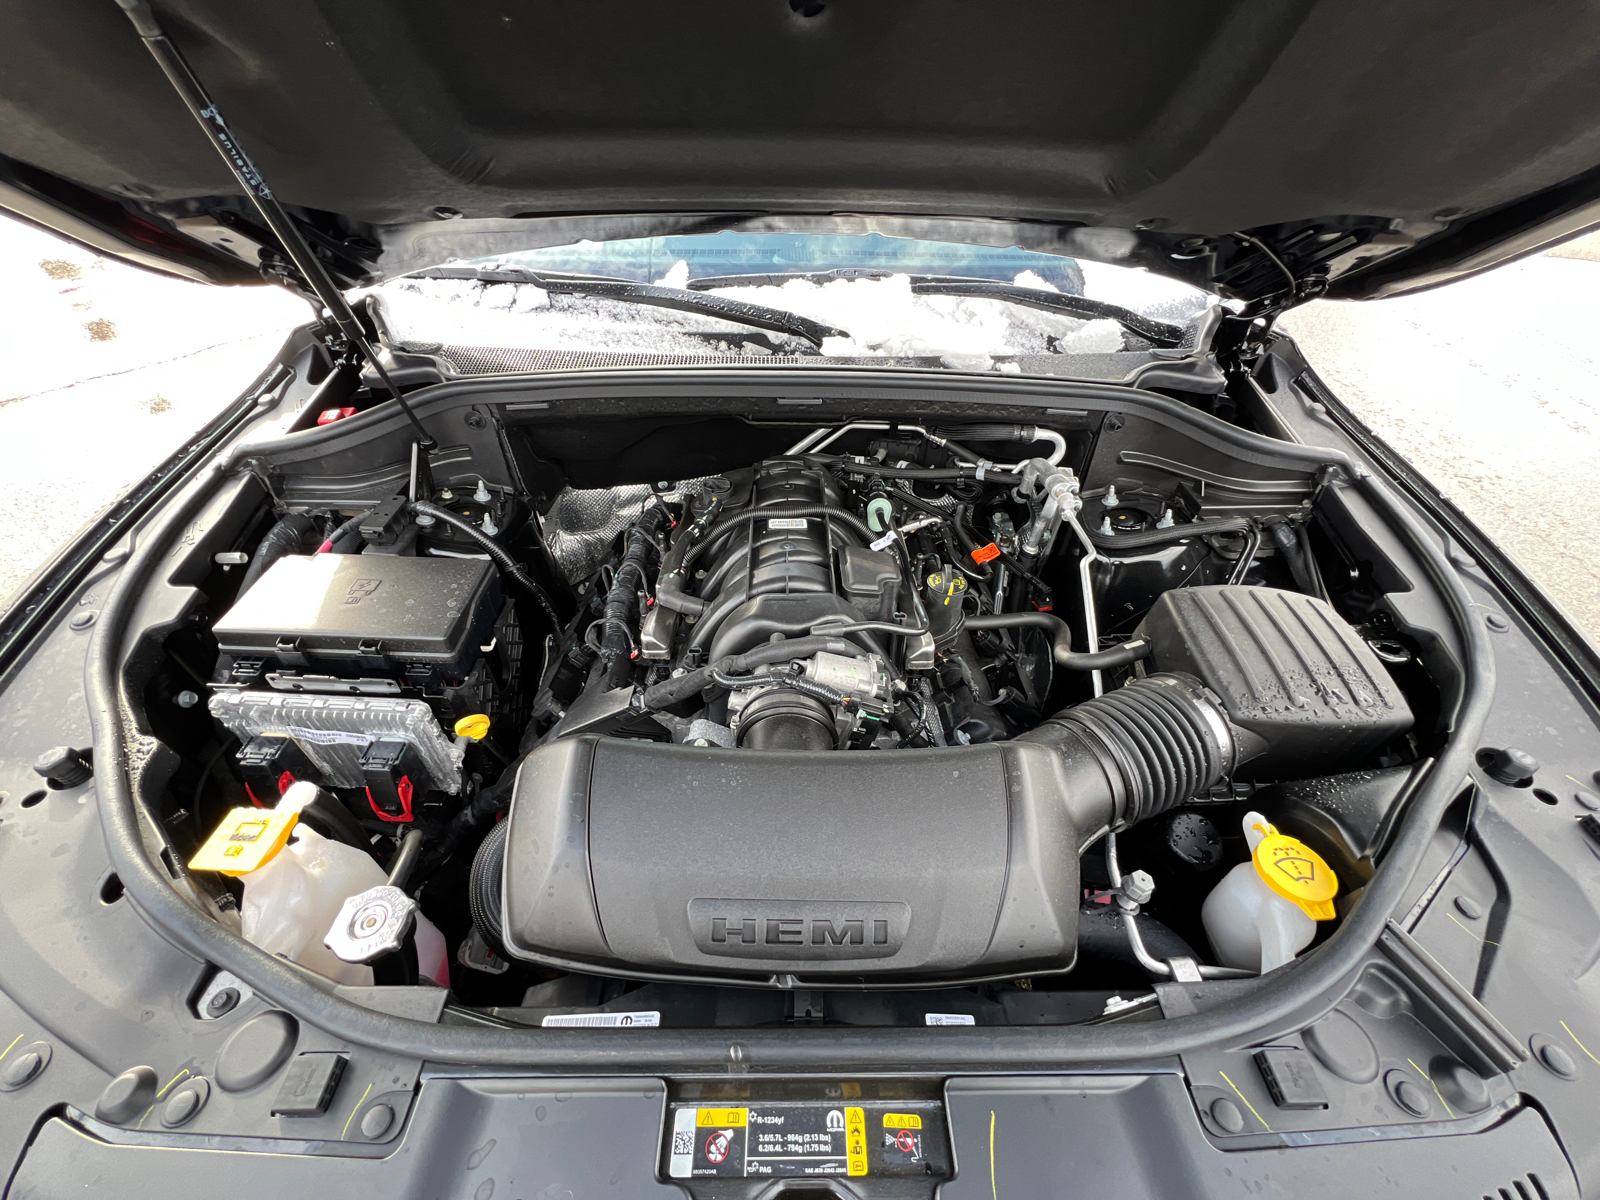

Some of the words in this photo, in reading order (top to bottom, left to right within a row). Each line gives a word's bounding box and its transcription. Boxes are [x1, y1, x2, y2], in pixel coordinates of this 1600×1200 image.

[219, 133, 258, 186] STABILUS
[712, 918, 888, 945] HEMI
[757, 1116, 784, 1125] R-1234yf
[758, 1134, 783, 1142] 3.6/5.7L
[787, 1134, 803, 1143] 964g
[803, 1134, 819, 1143] (2.13
[820, 1134, 831, 1143] lbs)
[758, 1144, 783, 1152] 6.2/6.4L
[787, 1144, 803, 1153] 794g
[803, 1144, 819, 1153] (1.75
[820, 1144, 831, 1153] lbs)
